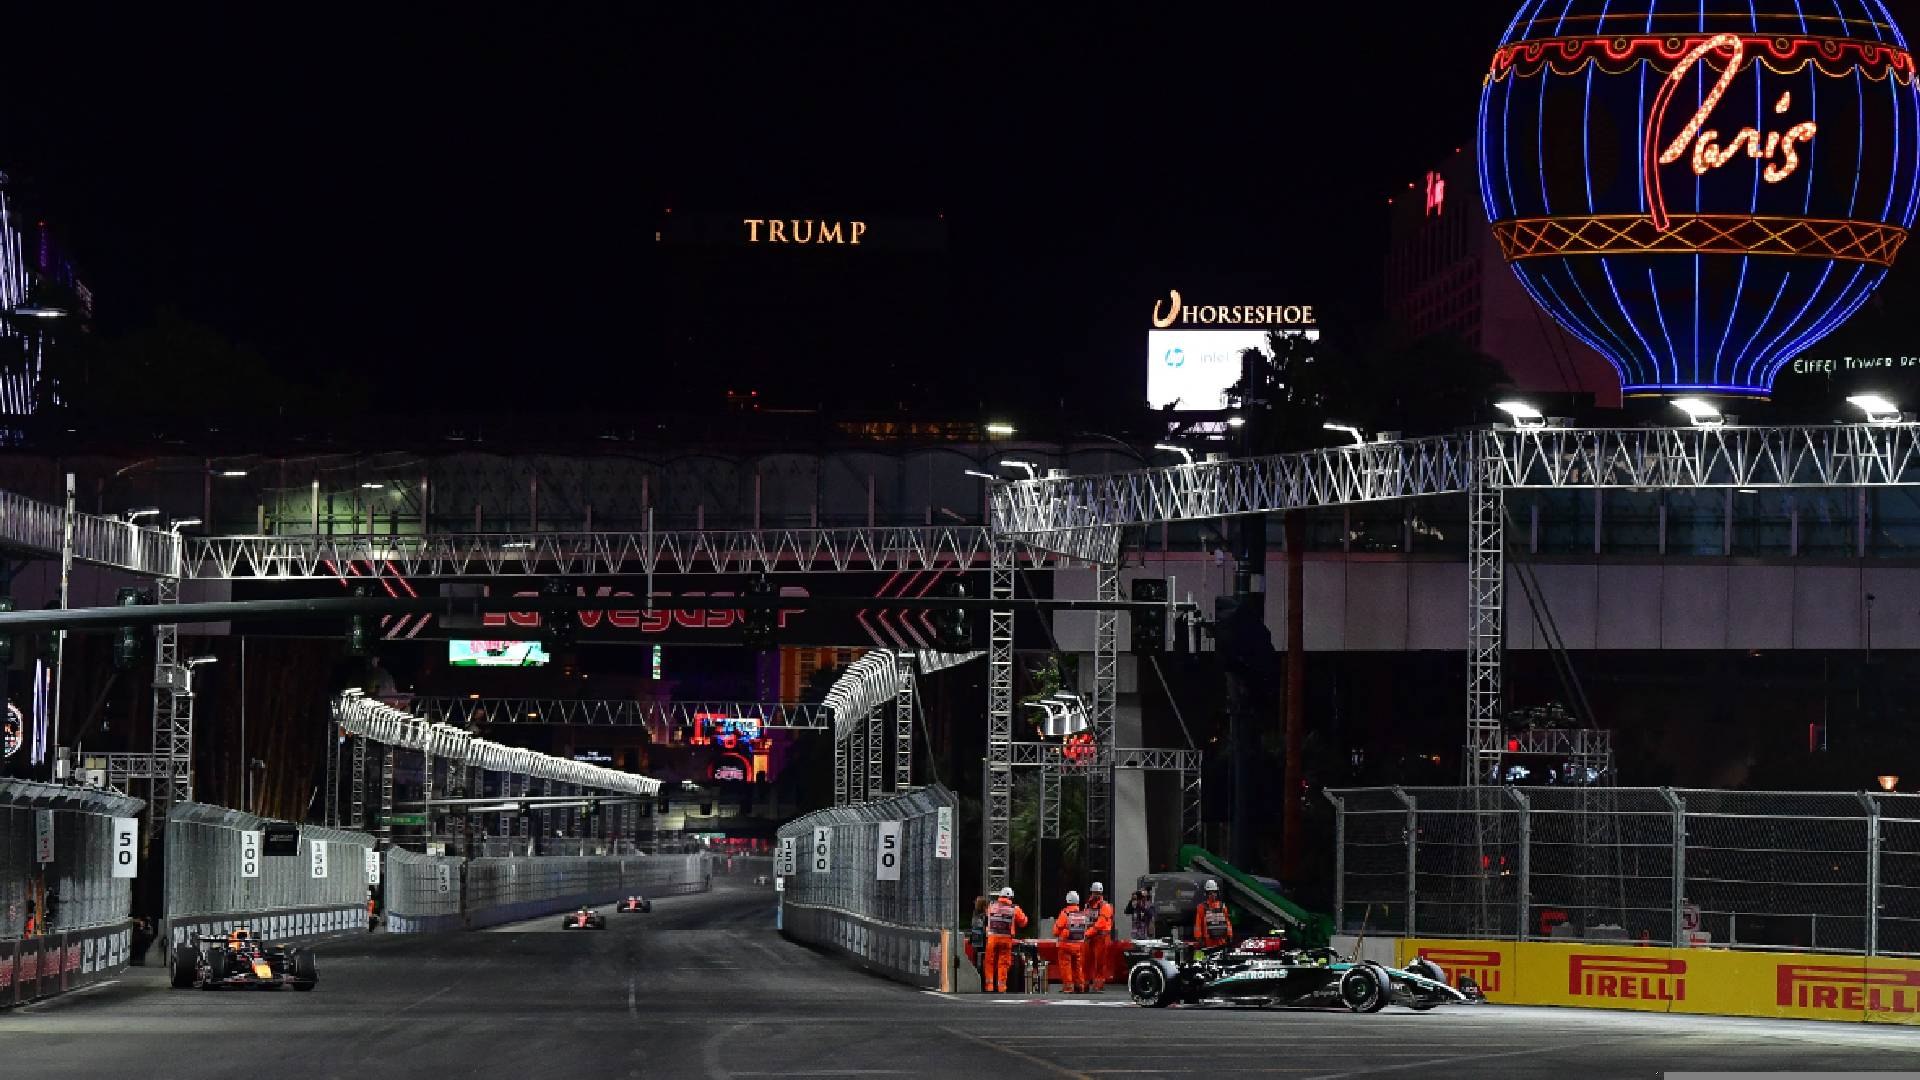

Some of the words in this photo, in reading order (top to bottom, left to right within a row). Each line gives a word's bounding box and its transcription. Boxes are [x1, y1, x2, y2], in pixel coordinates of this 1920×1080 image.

[1644, 33, 1817, 232] Paris
[743, 219, 868, 244] TRUMP
[118, 832, 132, 865] 50
[244, 834, 256, 875] 100
[314, 842, 324, 876] 150
[784, 840, 793, 873] 150
[816, 830, 828, 870] 100
[882, 834, 896, 868] 50
[1569, 955, 1687, 1001] PIRELLI
